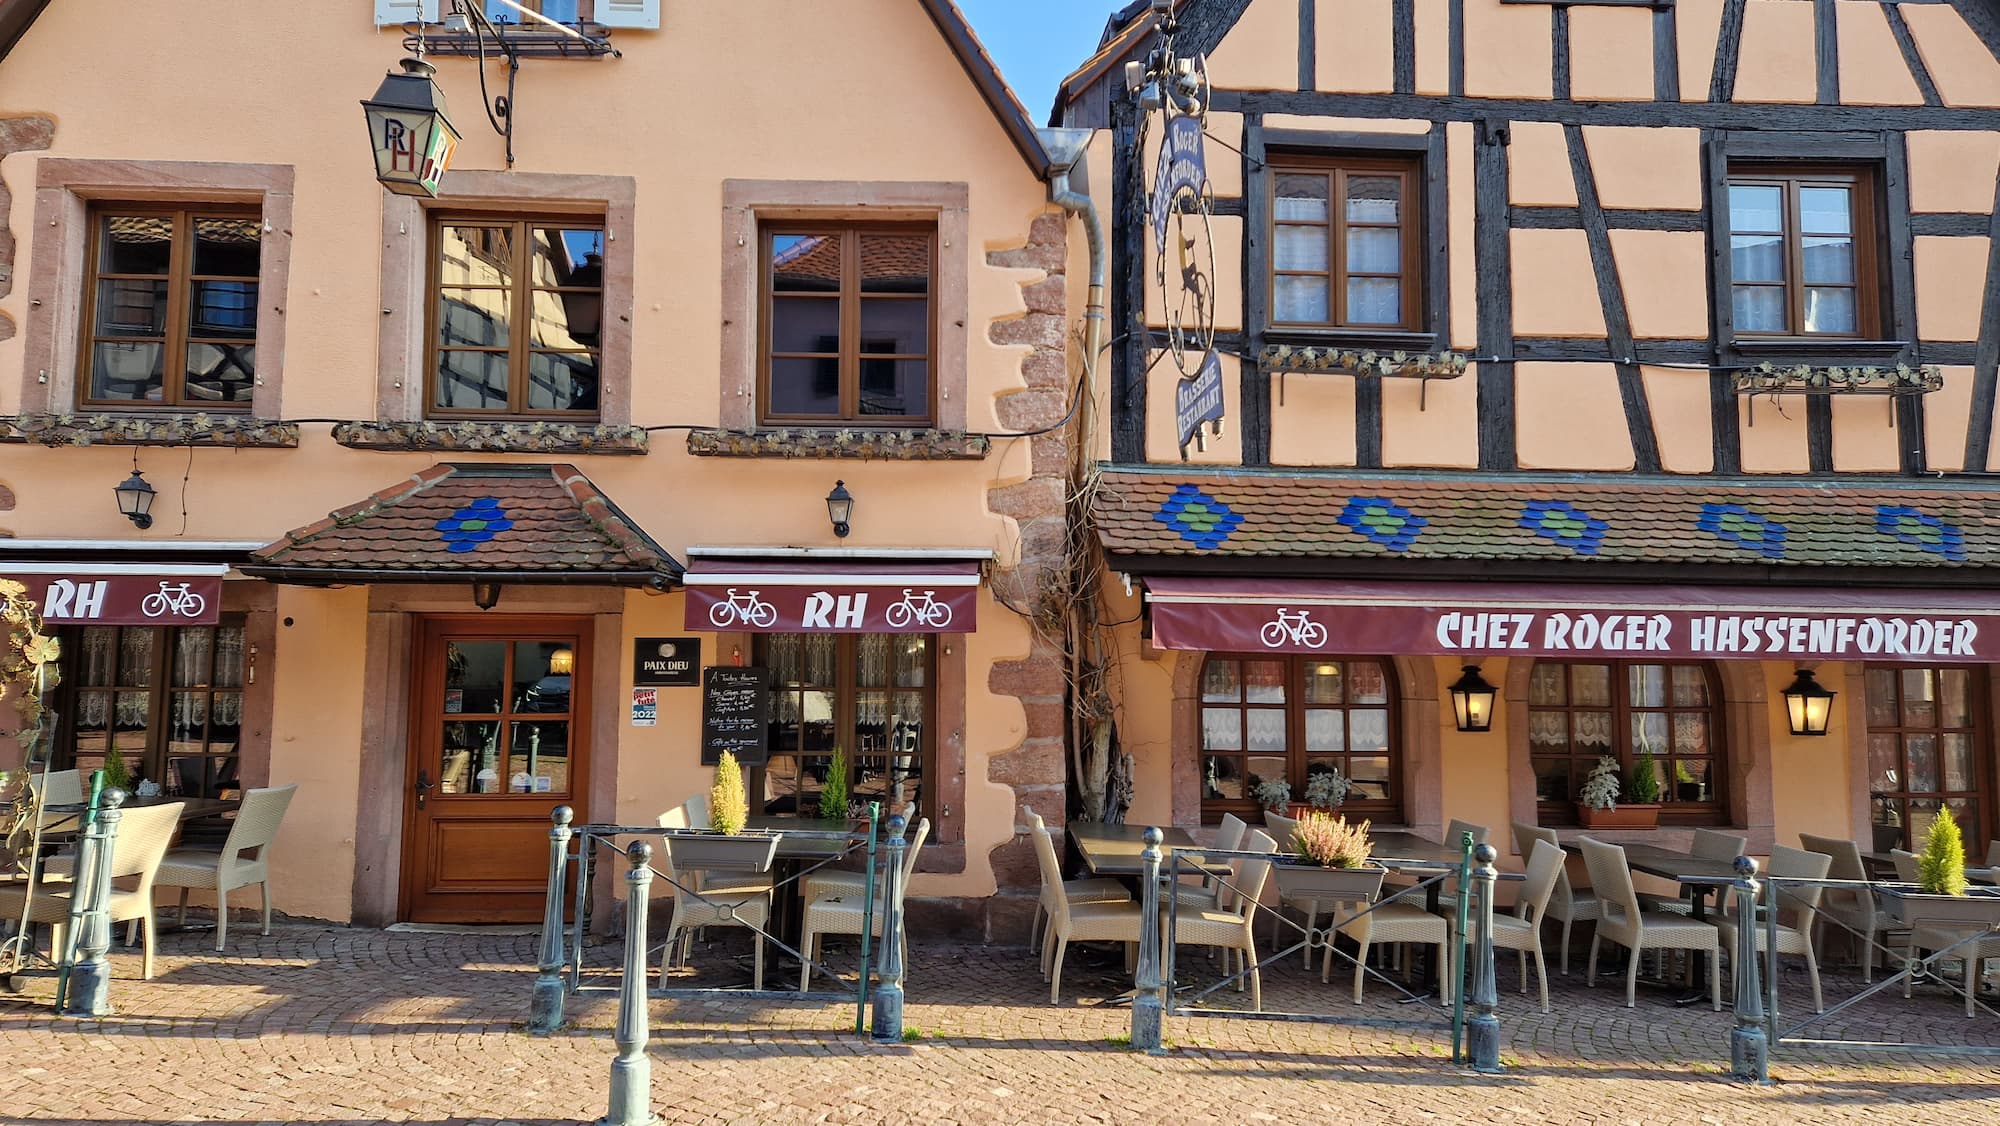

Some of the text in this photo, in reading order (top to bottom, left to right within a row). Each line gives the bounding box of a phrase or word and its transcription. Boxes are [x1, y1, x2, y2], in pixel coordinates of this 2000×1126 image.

[385, 118, 415, 171] RH
[1173, 123, 1199, 155] ROGER
[1178, 361, 1217, 414] BRASSERIE
[1178, 384, 1220, 442] RESTAURANT
[43, 578, 108, 618] RH
[802, 591, 868, 628] RH
[1436, 612, 1978, 656] CHEZ ROGER HASSENFORDER
[644, 660, 689, 671] PAIX DIEU
[632, 710, 656, 719] 2022
